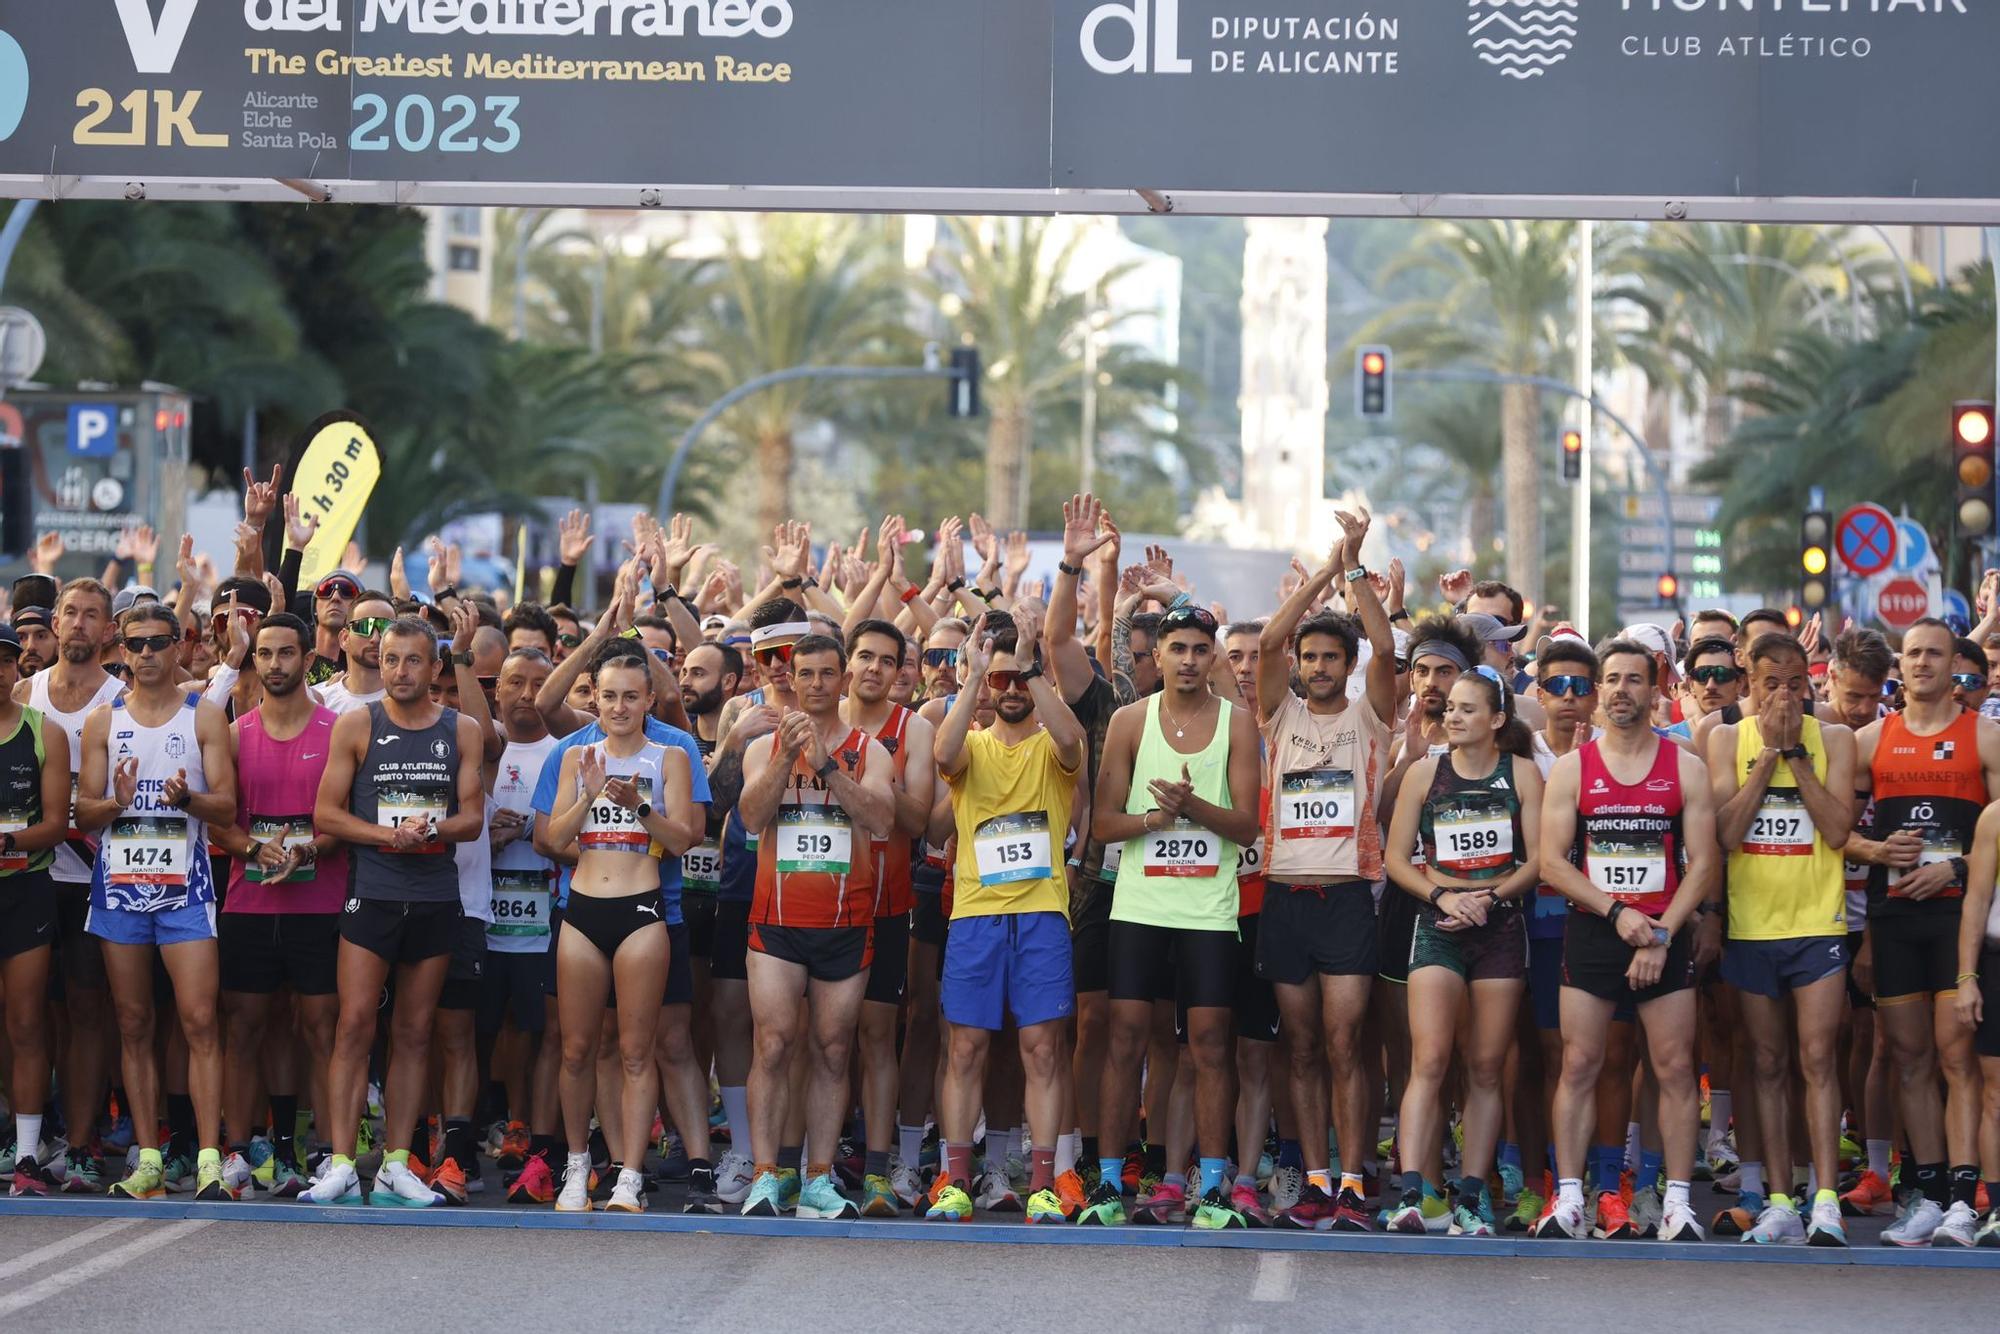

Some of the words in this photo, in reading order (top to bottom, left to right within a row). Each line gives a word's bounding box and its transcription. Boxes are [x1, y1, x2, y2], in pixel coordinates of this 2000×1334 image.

[1211, 12, 1399, 41] DIPUTACIÓN
[1621, 36, 1702, 56] CLUB
[1717, 33, 1871, 57] ATLÉTICO
[245, 48, 307, 75] The
[315, 49, 453, 77] Greatest
[463, 53, 706, 82] Mediterranean
[714, 55, 793, 83] Race
[1211, 50, 1246, 73] DE
[1256, 51, 1399, 74] ALICANTE
[243, 91, 319, 110] Alicante
[73, 87, 229, 148] 21K
[243, 111, 293, 129] Elche
[348, 92, 522, 153] 2023
[241, 131, 294, 149] Santa
[299, 132, 338, 150] Pola
[77, 409, 109, 450] P
[312, 494, 334, 513] h
[325, 461, 350, 493] 30
[344, 437, 363, 461] m
[1880, 593, 1926, 613] STOP
[378, 763, 400, 771] CLUB
[401, 762, 447, 771] ATLETISMO
[373, 773, 403, 783] PUERTO
[405, 773, 450, 781] TORREVIEJA
[1293, 801, 1339, 819] 1100
[1593, 803, 1642, 815] atletismo
[1644, 803, 1666, 815] club
[1586, 818, 1672, 831] MANCHATHON
[1753, 817, 1801, 837] 2197
[796, 834, 832, 853] 519
[1155, 839, 1208, 858] 2870
[1449, 829, 1499, 852] 1589
[123, 847, 173, 867] 1474
[996, 842, 1033, 864] 153
[1604, 866, 1649, 885] 1517
